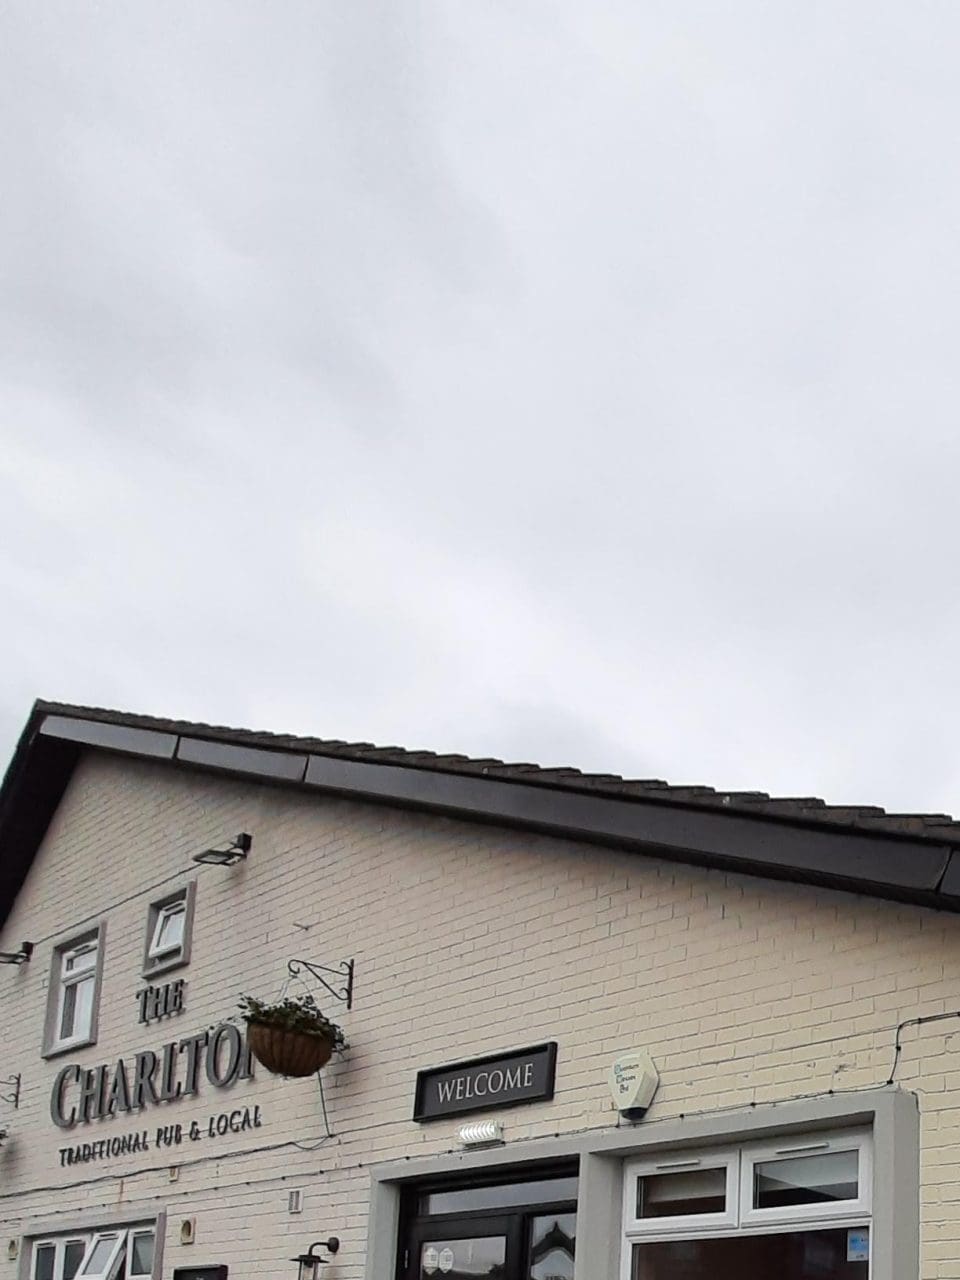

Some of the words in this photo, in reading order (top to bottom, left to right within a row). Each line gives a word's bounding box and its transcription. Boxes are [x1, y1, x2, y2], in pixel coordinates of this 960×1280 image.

[136, 978, 187, 1024] THE
[437, 1062, 534, 1104] WELCOME
[59, 1130, 149, 1166] TRADITIONAL
[156, 1123, 182, 1149] PUB
[188, 1120, 201, 1141] &
[208, 1105, 261, 1138] LOCAL
